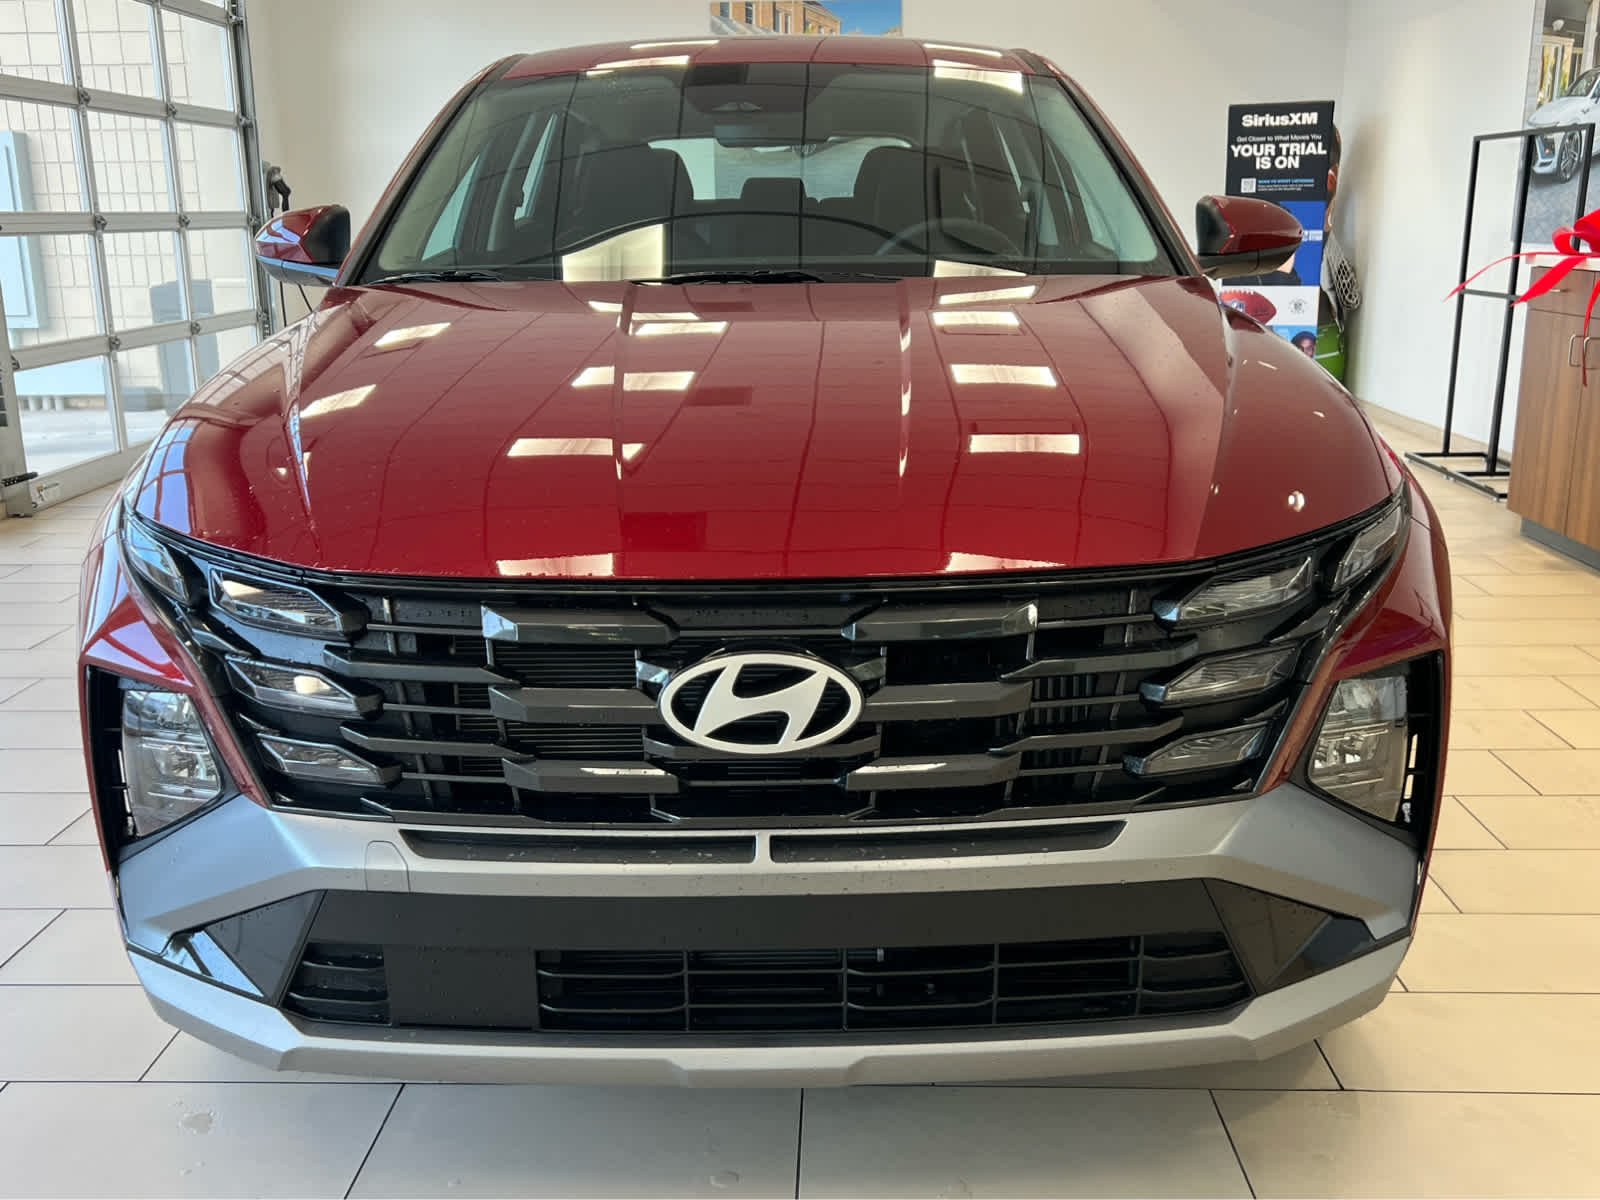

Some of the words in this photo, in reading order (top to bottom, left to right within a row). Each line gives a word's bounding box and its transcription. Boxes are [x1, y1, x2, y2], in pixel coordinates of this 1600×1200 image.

[1241, 111, 1318, 127] SiriusXM
[1230, 143, 1276, 157] YOUR
[1279, 142, 1328, 155] TRIAL
[1255, 156, 1271, 170] IS
[1274, 155, 1300, 169] ON
